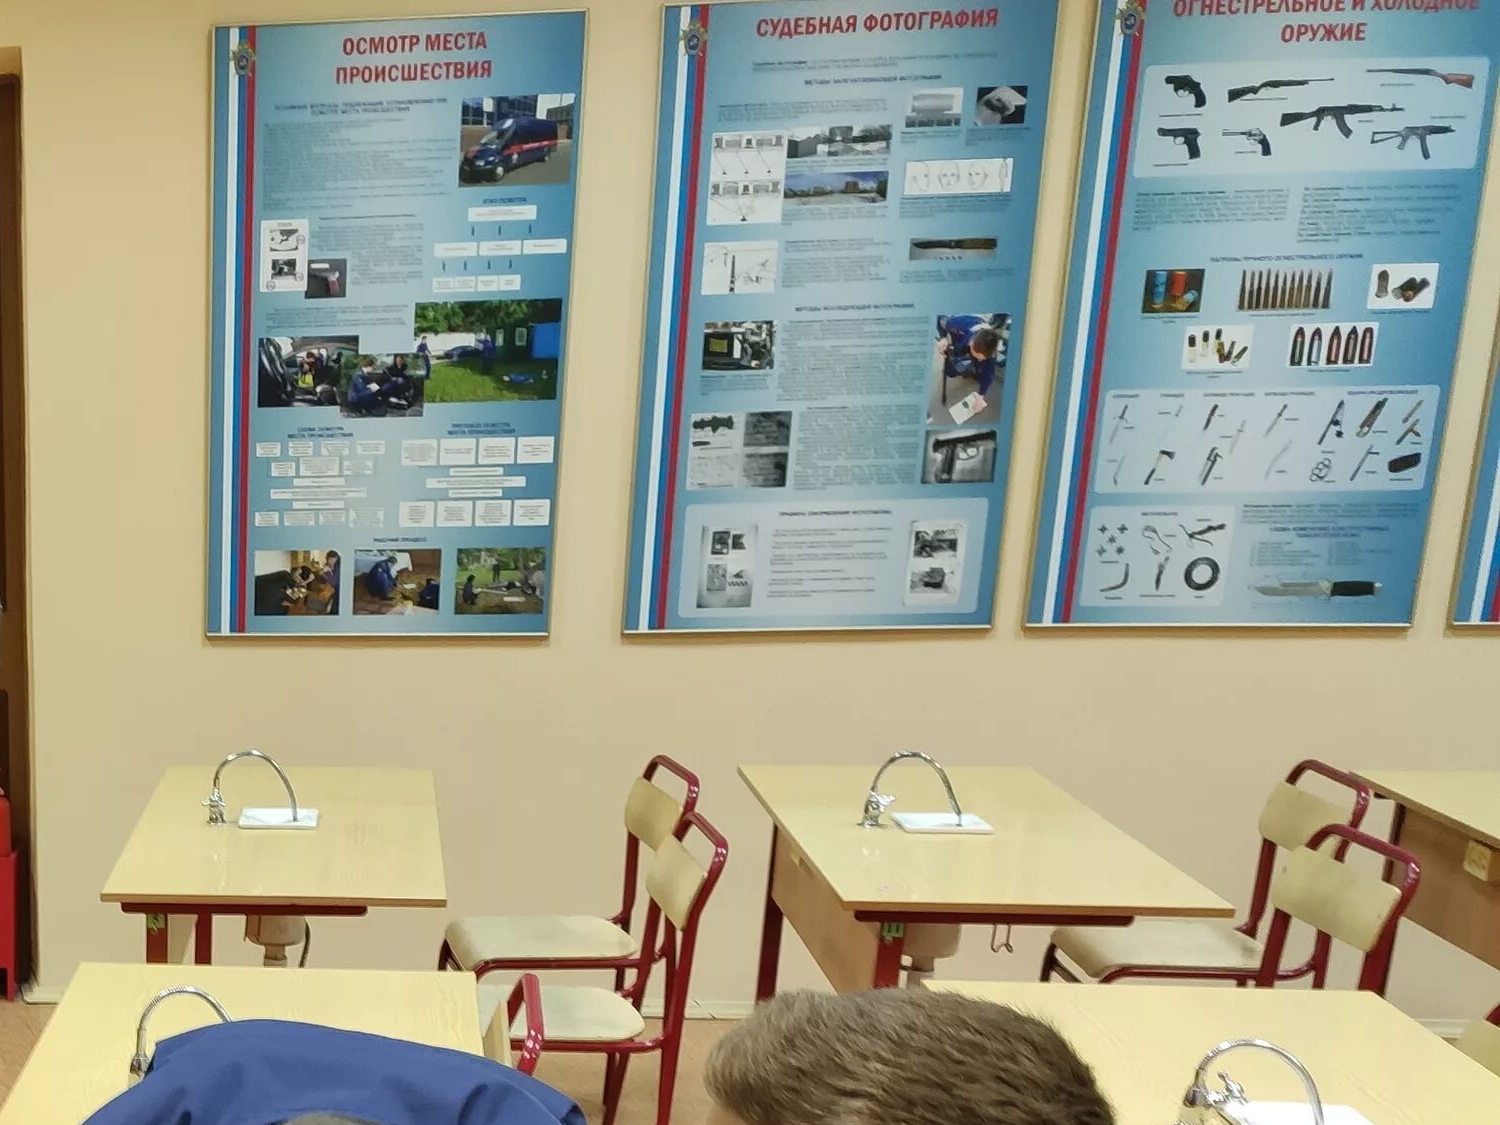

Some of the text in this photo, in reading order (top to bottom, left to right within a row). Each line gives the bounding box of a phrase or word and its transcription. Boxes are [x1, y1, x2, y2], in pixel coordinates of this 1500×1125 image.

[756, 8, 999, 39] СУДЕБНАЯ ФОТОГРАФИЯ
[1280, 22, 1367, 43] ОРУЖИЕ
[342, 31, 488, 56] ОСМОТР МЕСТА
[335, 60, 493, 84] ПРОИСШЕСТВИЯ
